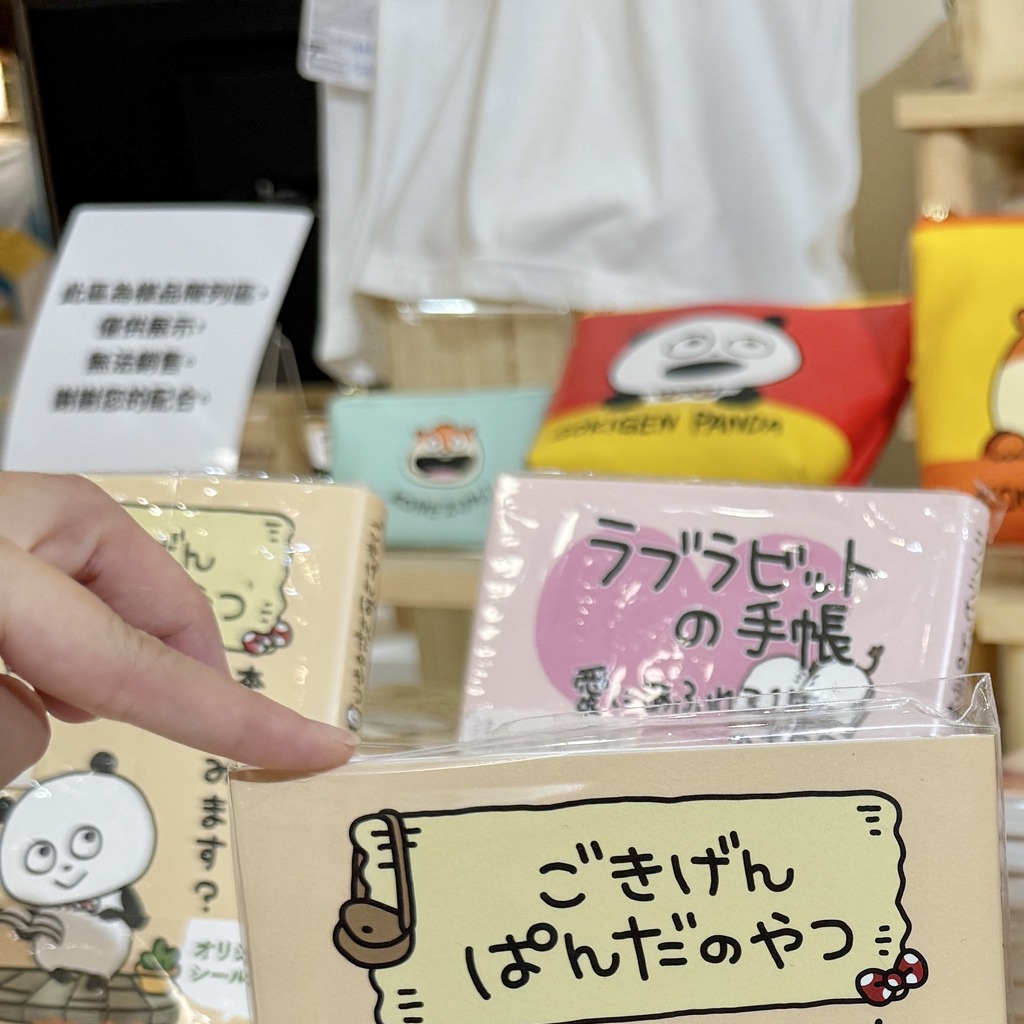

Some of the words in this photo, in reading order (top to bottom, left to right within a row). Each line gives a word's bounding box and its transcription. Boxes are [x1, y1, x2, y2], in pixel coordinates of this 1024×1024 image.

[590, 517, 881, 598] ラブラビット
[674, 601, 855, 667] の手帳
[540, 831, 795, 908] ごきげん
[464, 912, 855, 1001] ぱんだのやつ
